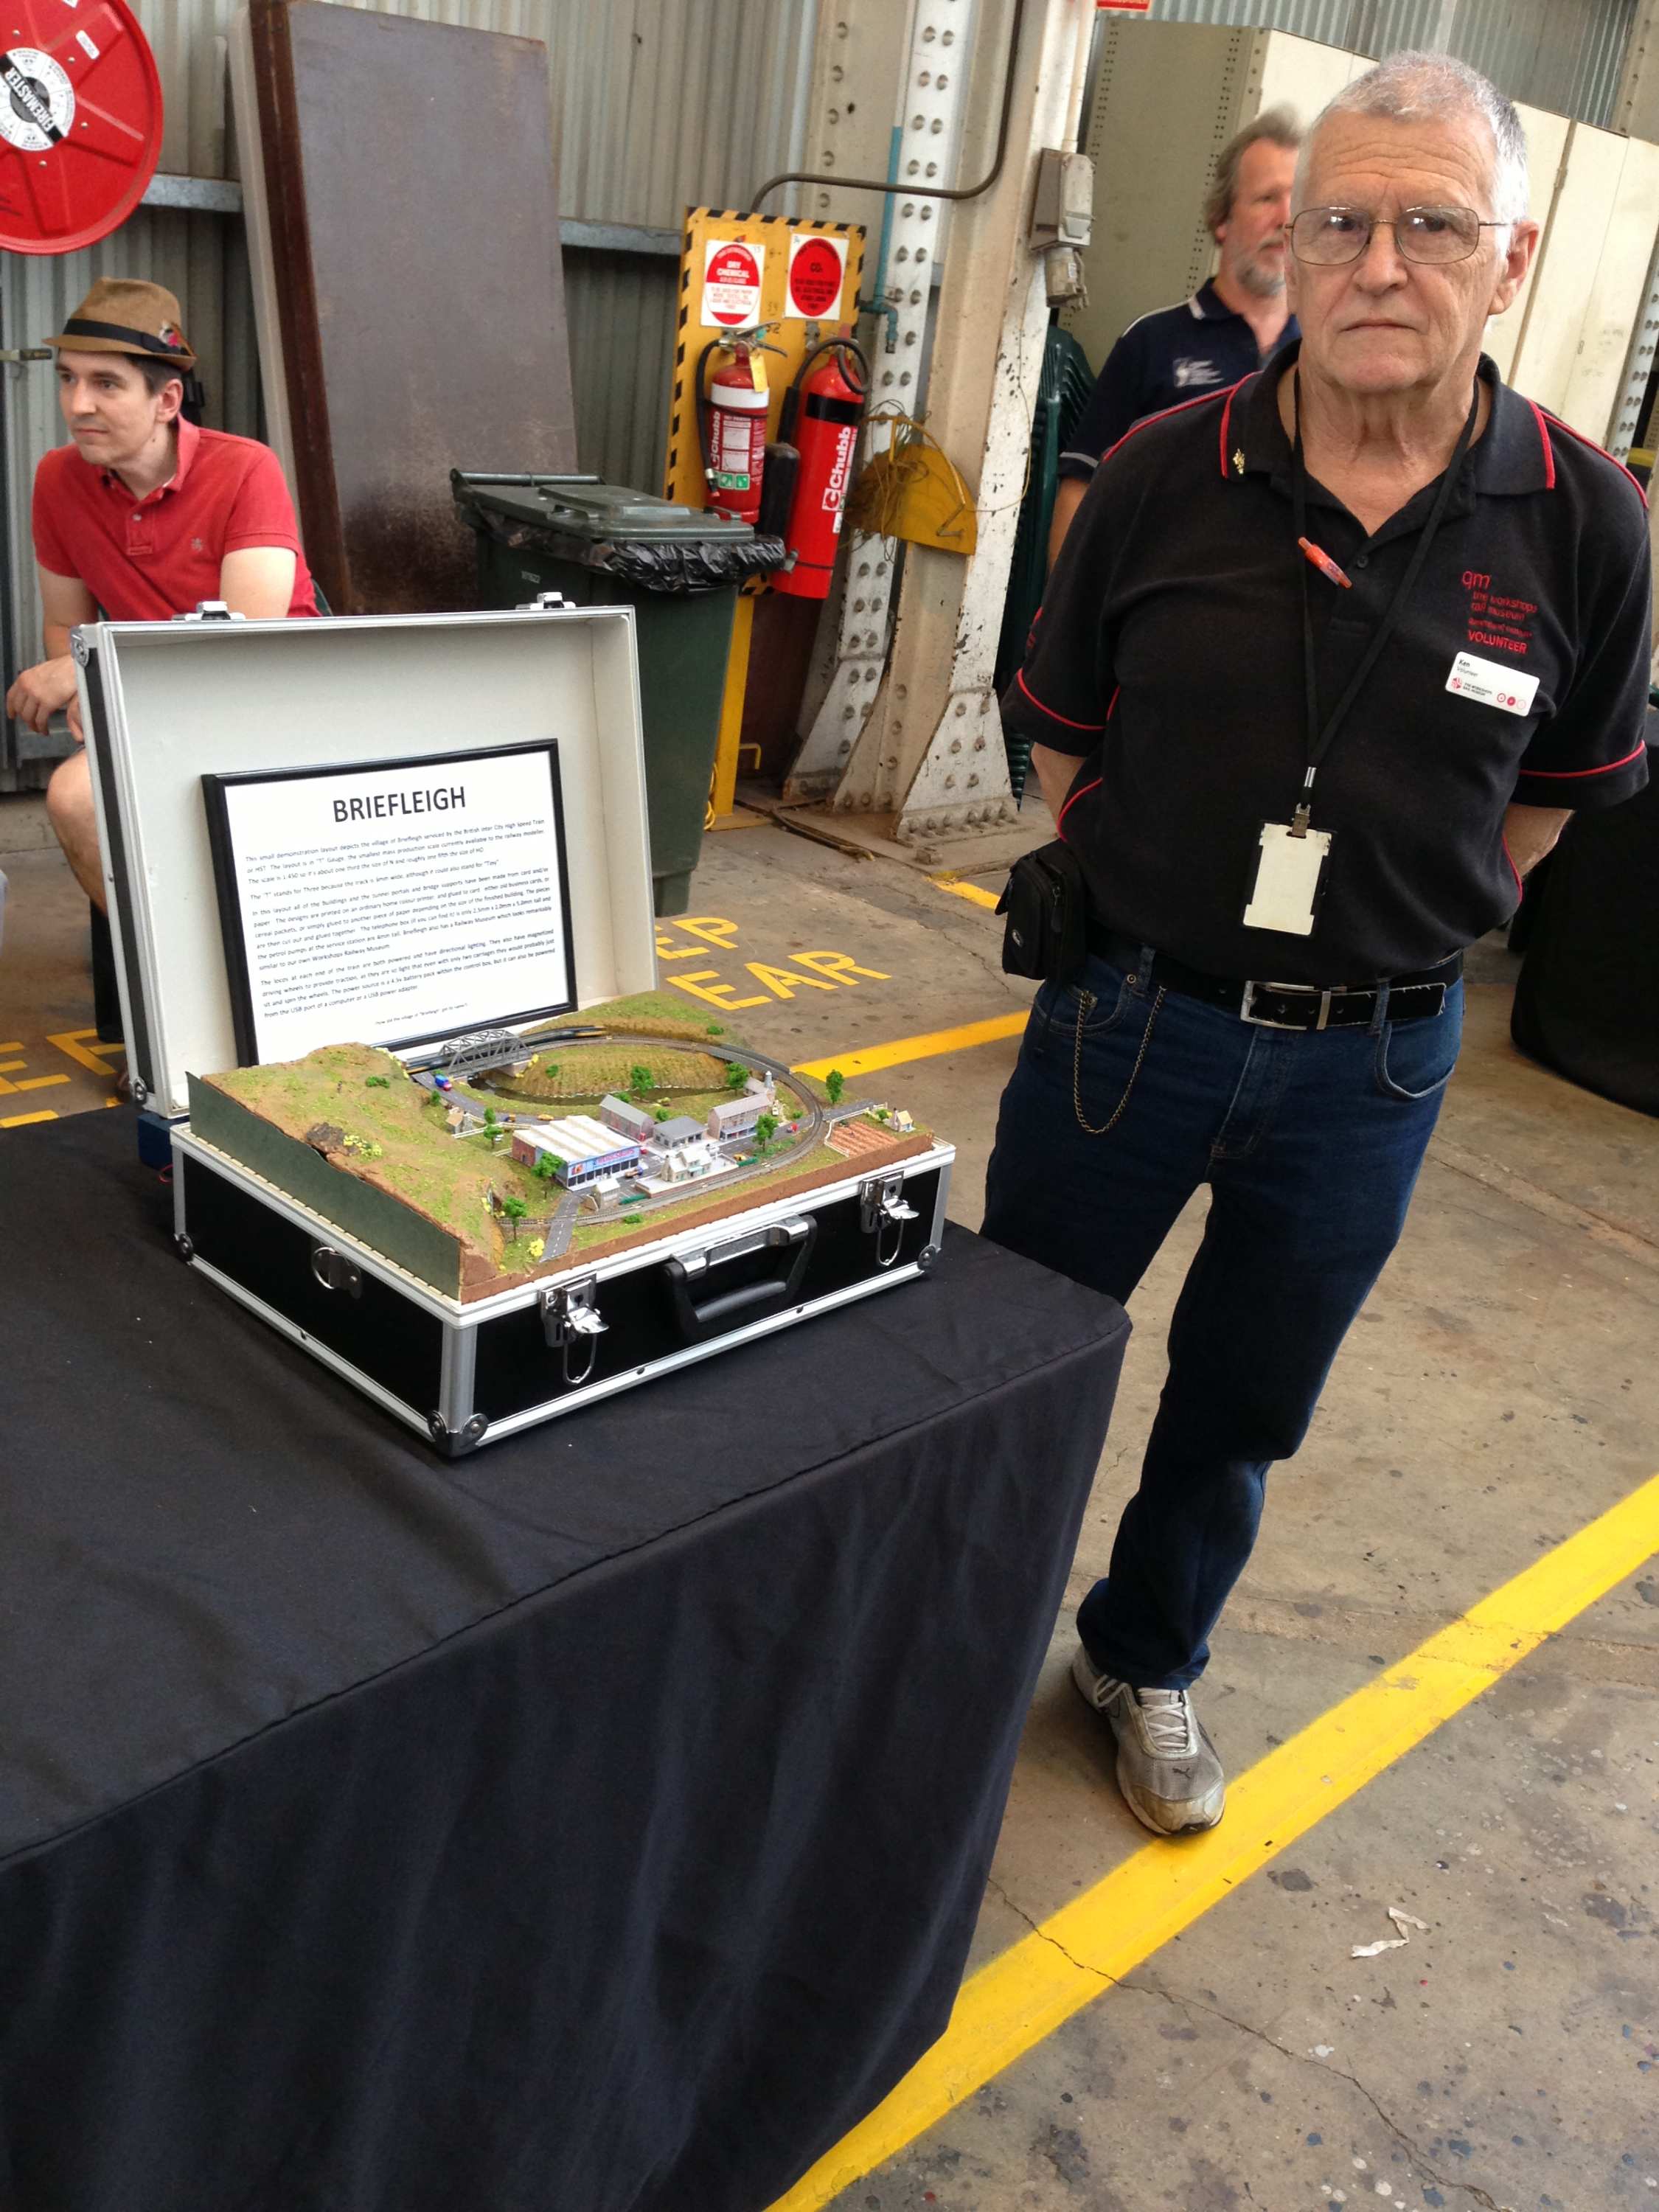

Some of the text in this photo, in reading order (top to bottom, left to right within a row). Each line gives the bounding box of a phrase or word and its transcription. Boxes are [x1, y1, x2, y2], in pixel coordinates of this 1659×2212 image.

[4, 66, 56, 133] FIREMASTER
[711, 411, 720, 454] Chubb
[829, 426, 851, 489] Chubb
[1461, 570, 1491, 589] qm
[1468, 630, 1527, 654] VOLUNTEER
[333, 786, 465, 823] BRIEFLEIGH
